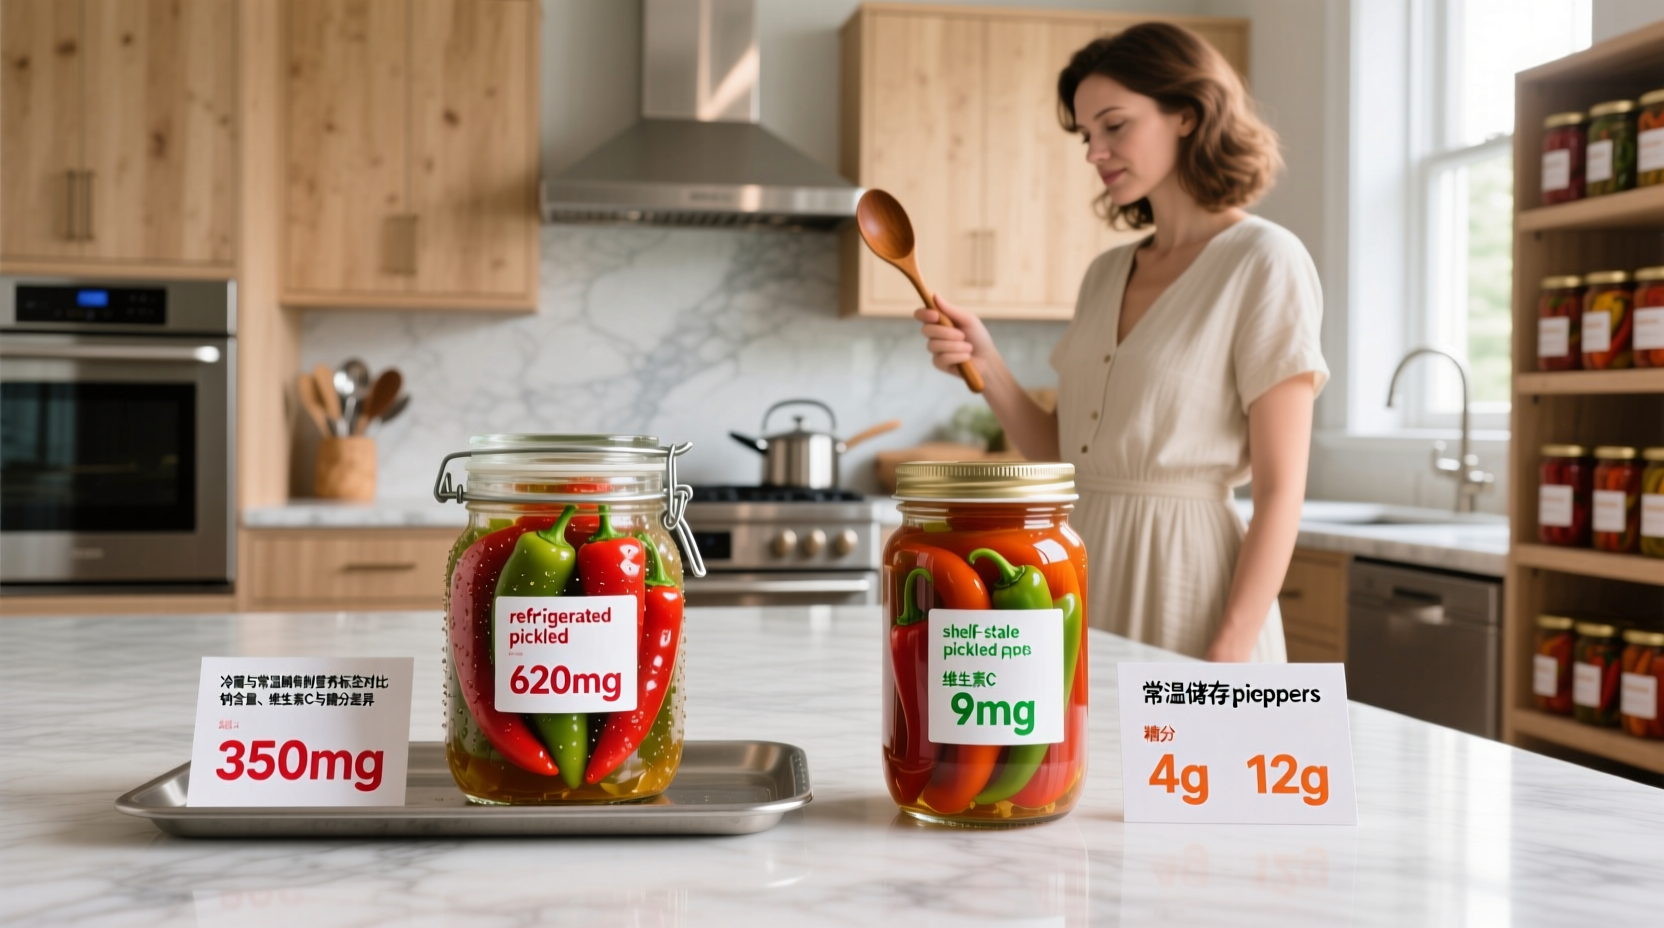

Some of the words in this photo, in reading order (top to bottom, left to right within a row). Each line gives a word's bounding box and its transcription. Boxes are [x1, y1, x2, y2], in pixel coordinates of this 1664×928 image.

[510, 607, 611, 628] refrigerated
[509, 628, 569, 649] pickled
[944, 642, 998, 660] pickled
[510, 665, 621, 702] 620mg
[951, 692, 1035, 736] 9mg
[216, 740, 384, 792] 350mg
[1149, 754, 1209, 806] 4g
[1247, 754, 1329, 806] 12g
